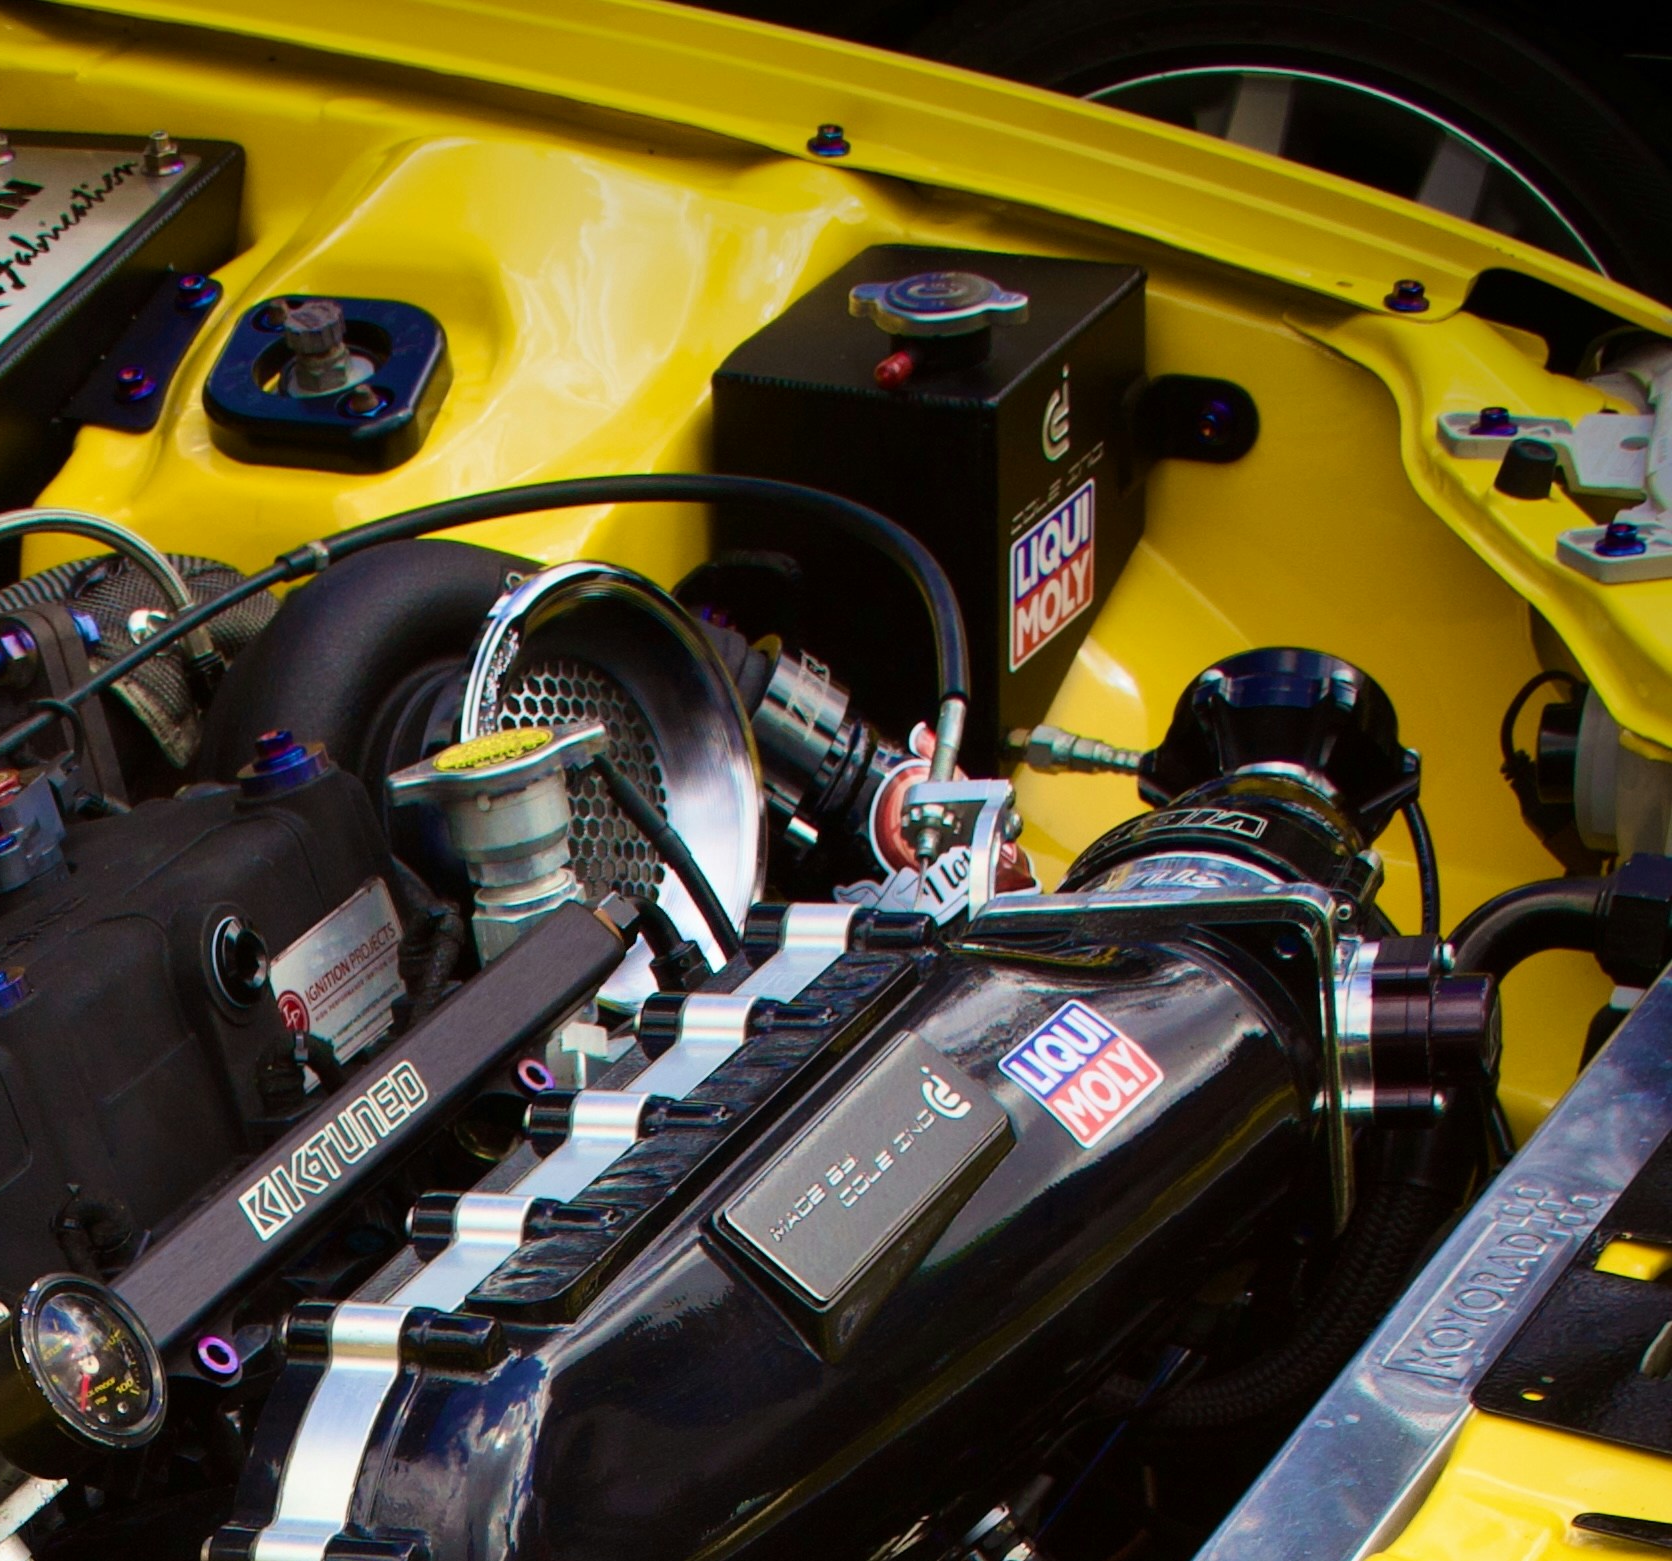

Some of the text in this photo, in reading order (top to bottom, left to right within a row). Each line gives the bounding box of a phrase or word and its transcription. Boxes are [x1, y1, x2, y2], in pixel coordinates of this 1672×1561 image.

[1016, 491, 1090, 599] LIQUI
[1015, 549, 1090, 658] MOLY
[304, 922, 397, 1006] IGNITION PROJECTS
[1008, 1007, 1113, 1092] LIQUI
[1052, 1043, 1150, 1136] MOLY
[838, 1107, 937, 1209] COLE IND
[769, 1182, 827, 1243] MADE
[1400, 1233, 1553, 1373] KOYORAD
